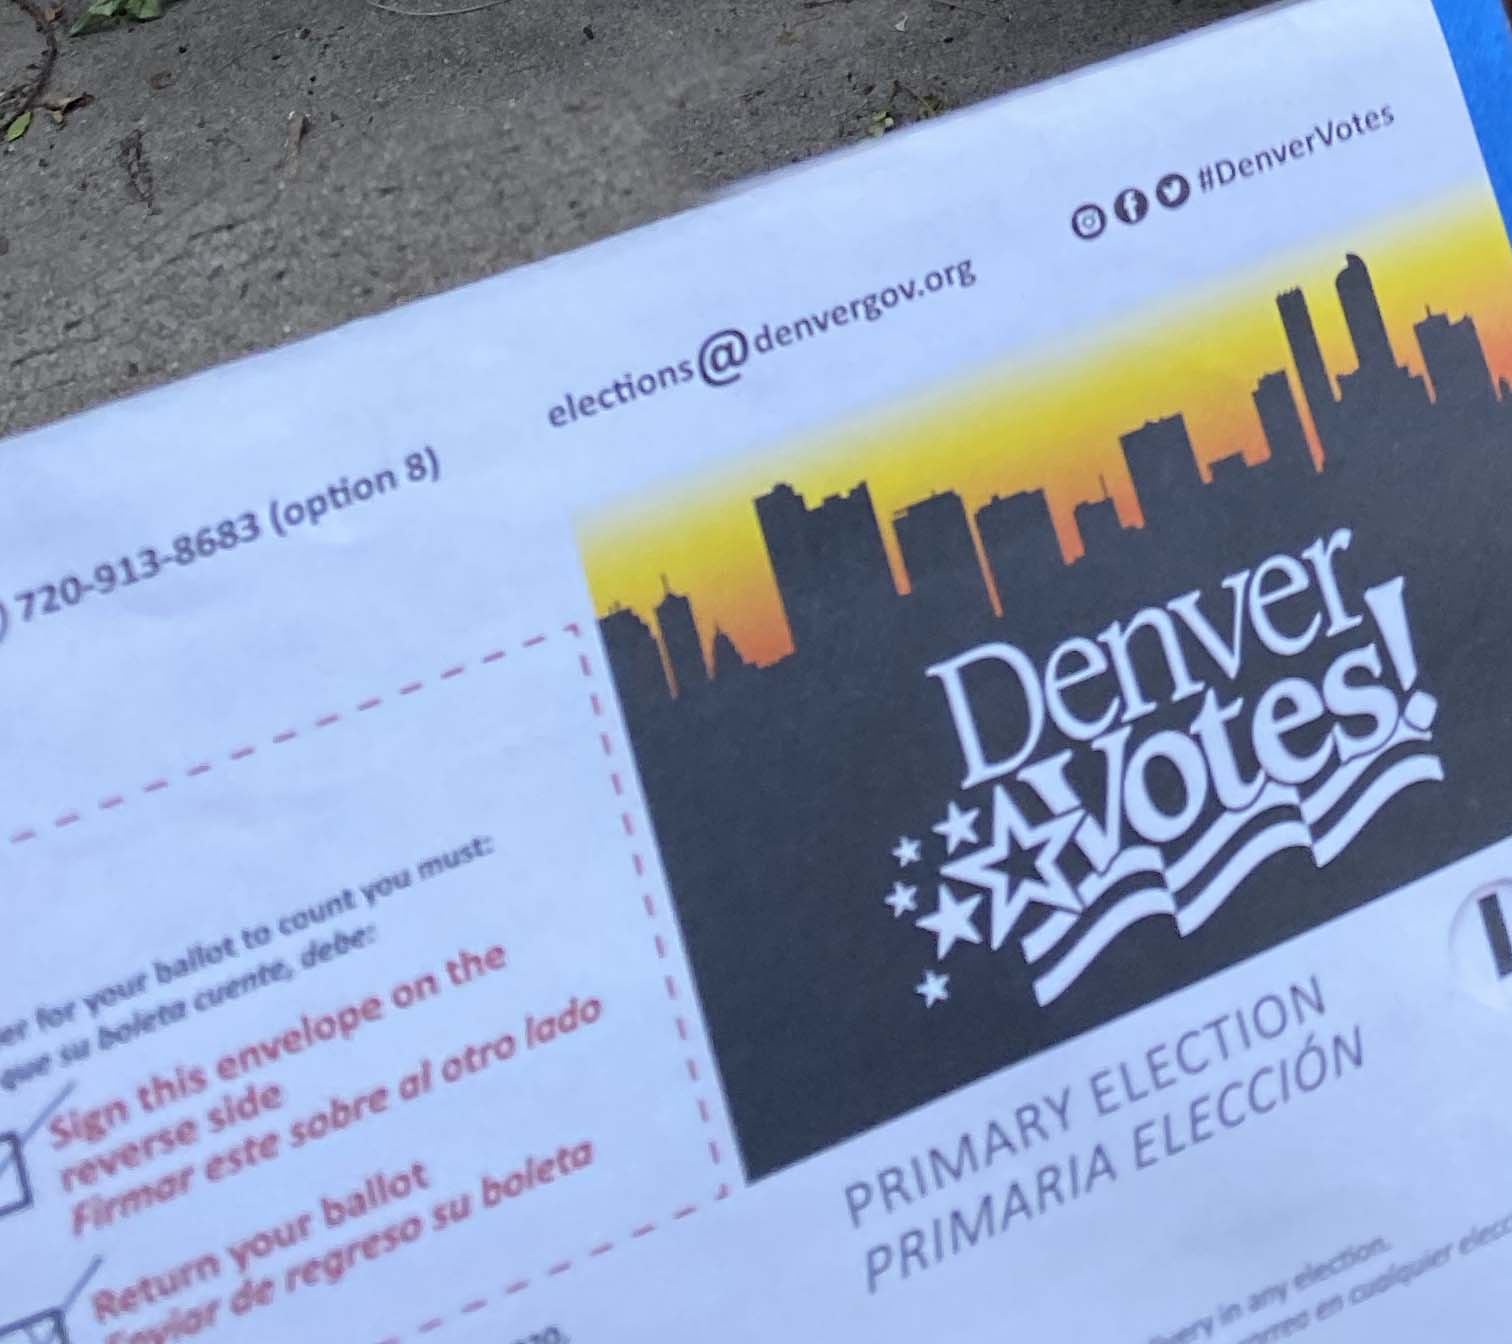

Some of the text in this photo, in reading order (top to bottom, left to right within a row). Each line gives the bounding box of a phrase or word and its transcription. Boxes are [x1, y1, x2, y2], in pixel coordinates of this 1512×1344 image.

[1198, 104, 1395, 194] #DenverVotes
[547, 252, 977, 430] elections@denvergov.org
[14, 445, 441, 622] 720-913-8683 (option 8)
[924, 525, 1365, 790] Denver
[1017, 576, 1438, 875] Votes!
[36, 1001, 75, 1031] for
[83, 972, 148, 1021] your
[153, 937, 238, 984] ballot
[241, 924, 271, 950] to
[278, 888, 356, 936] count
[360, 868, 412, 906] you
[50, 944, 507, 1150] Sign this envelope on the
[72, 997, 602, 1236] Firmar este sobre al otro lado
[844, 974, 1327, 1229] PRIMARY ELECTION
[60, 1084, 283, 1192] reverse side
[231, 1139, 594, 1315] de regreso su boleta
[866, 1025, 1365, 1294] PRIMARIA ELECCIÓN
[93, 1161, 430, 1324] Return your ballot
